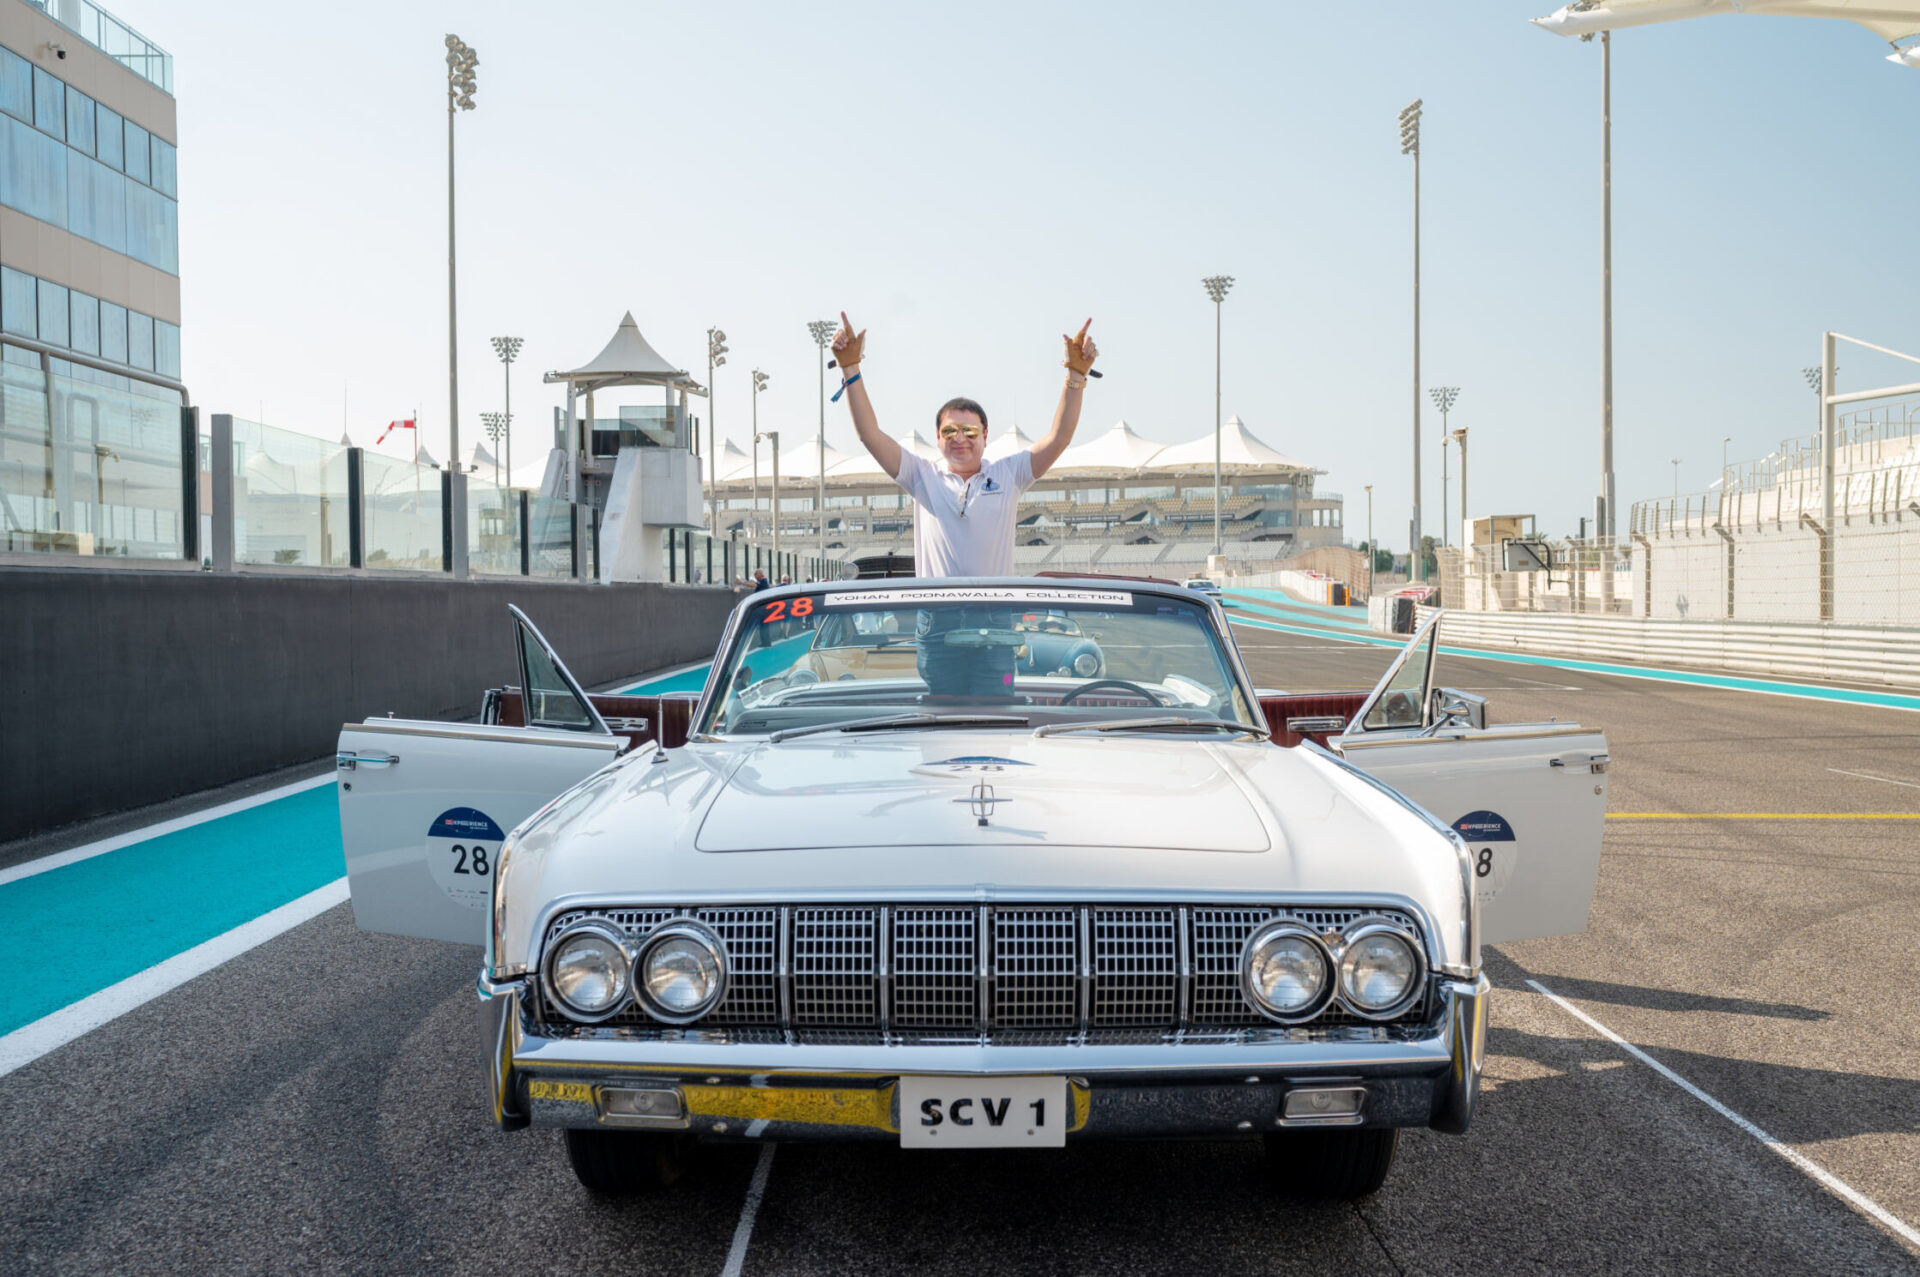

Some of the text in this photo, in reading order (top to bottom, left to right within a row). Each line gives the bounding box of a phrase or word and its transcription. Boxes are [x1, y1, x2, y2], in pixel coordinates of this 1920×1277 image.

[763, 597, 814, 624] 28
[1026, 592, 1124, 601] COLLECTION
[451, 844, 490, 876] 28
[1470, 847, 1493, 878] 8
[920, 1098, 1045, 1127] SCV 1
